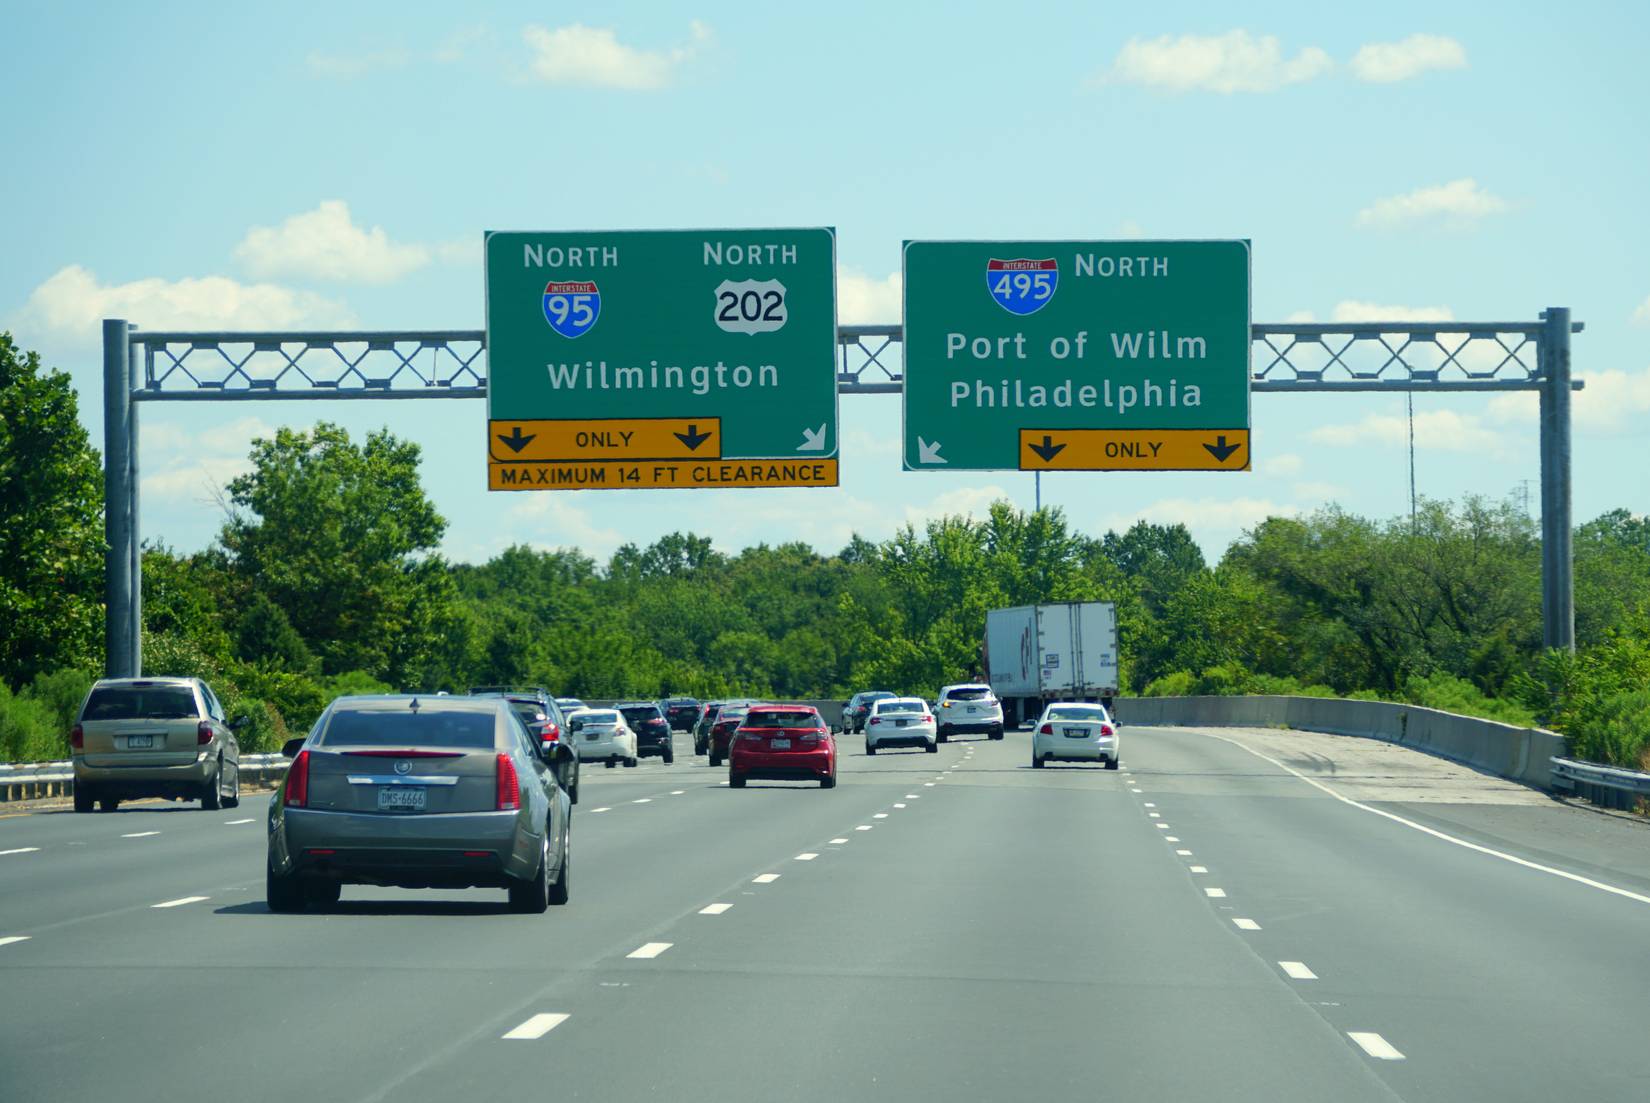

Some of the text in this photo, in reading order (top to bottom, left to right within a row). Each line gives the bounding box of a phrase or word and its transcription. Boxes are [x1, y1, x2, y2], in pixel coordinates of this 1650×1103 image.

[524, 244, 618, 267] NORTH
[704, 242, 797, 265] NORTH
[1076, 253, 1168, 277] NORTH
[1003, 262, 1042, 270] INTERSTATE
[993, 273, 1051, 300] 495
[548, 295, 593, 327] 95
[719, 290, 783, 322] 202
[947, 330, 1206, 359] Port of Wilm
[547, 360, 779, 395] Wilmington
[951, 379, 1202, 413] Philadelphia
[575, 431, 634, 448] ONLY
[1105, 441, 1163, 458] ONLY
[501, 465, 826, 484] MAXIMUM 14 FT CLEARANCE
